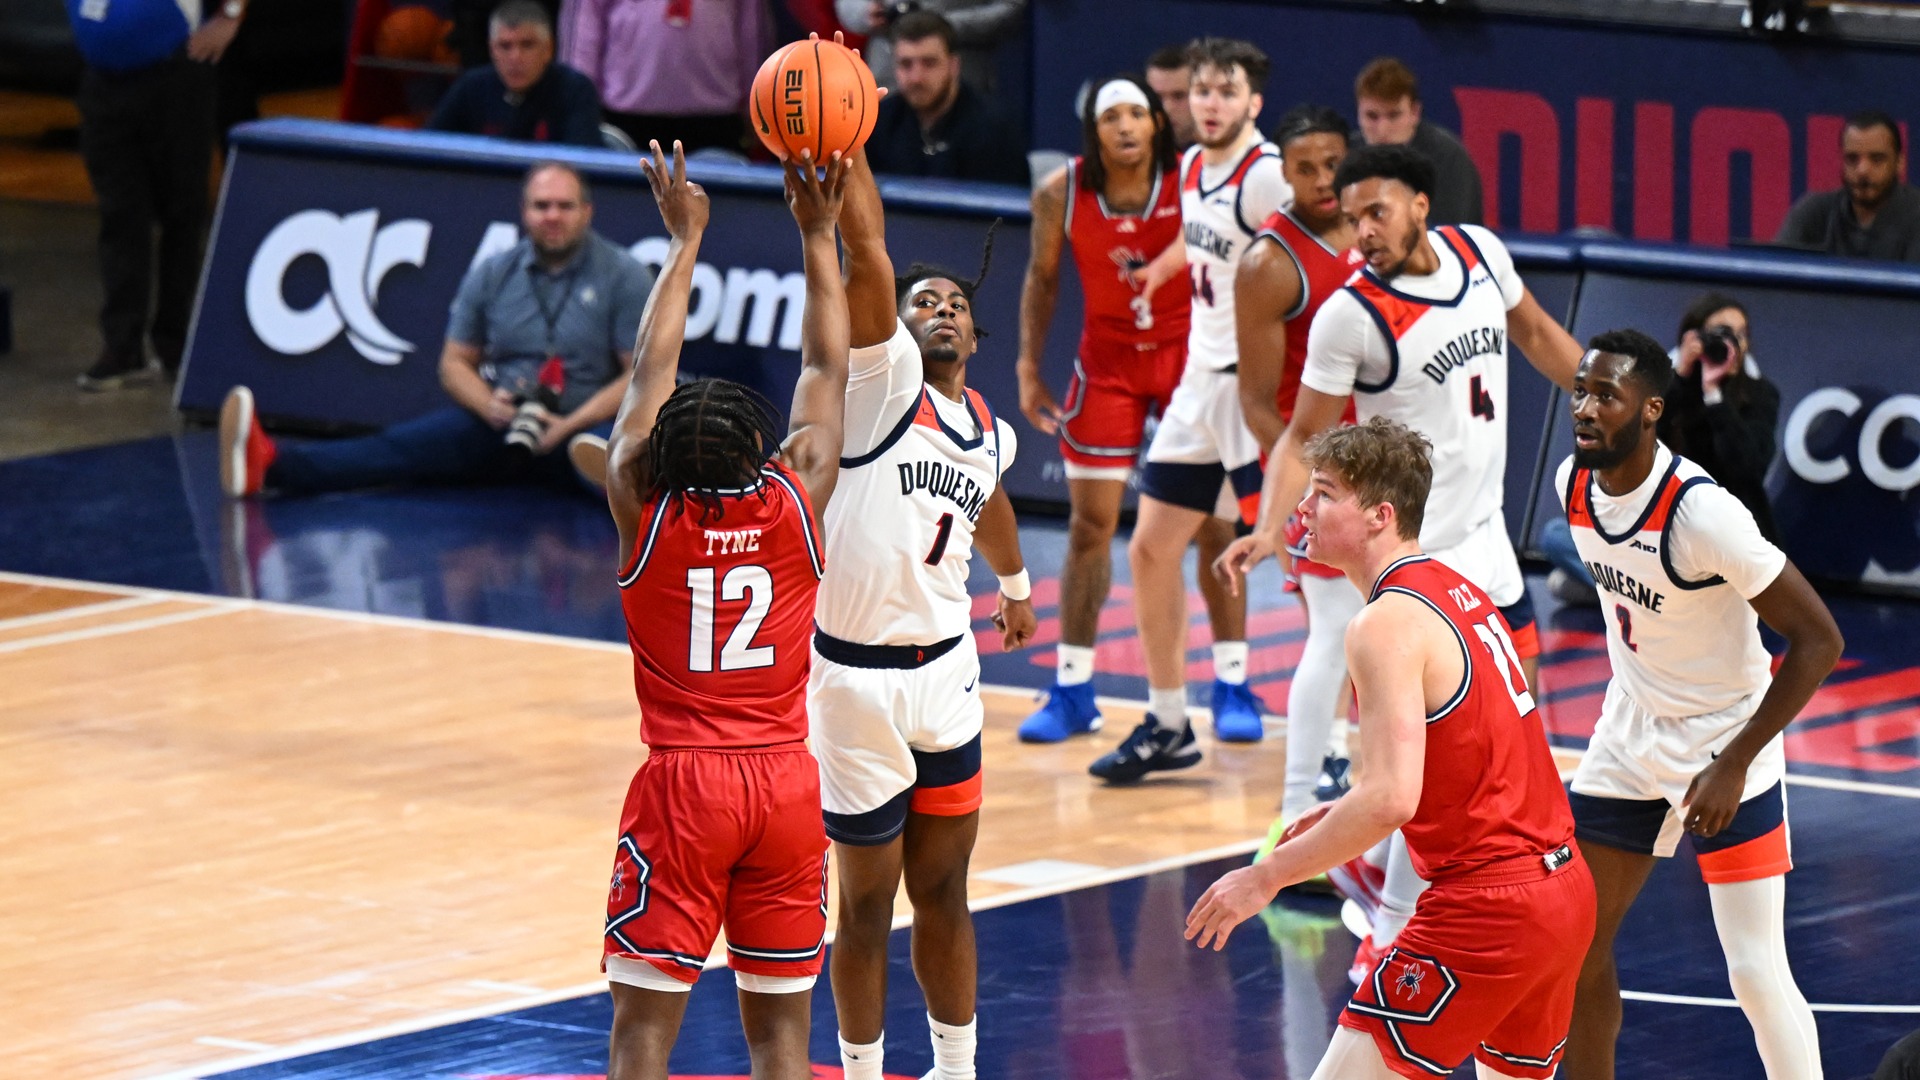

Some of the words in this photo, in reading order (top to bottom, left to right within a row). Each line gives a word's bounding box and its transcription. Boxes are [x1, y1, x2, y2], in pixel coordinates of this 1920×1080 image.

[785, 69, 805, 135] ELITE
[1129, 295, 1154, 330] 3
[1470, 374, 1495, 422] 4
[704, 529, 762, 556] TYNE
[924, 512, 954, 566] 1
[1629, 540, 1657, 553] A10
[686, 564, 776, 673] 12
[1615, 603, 1637, 653] 2
[1472, 612, 1536, 718] 21
